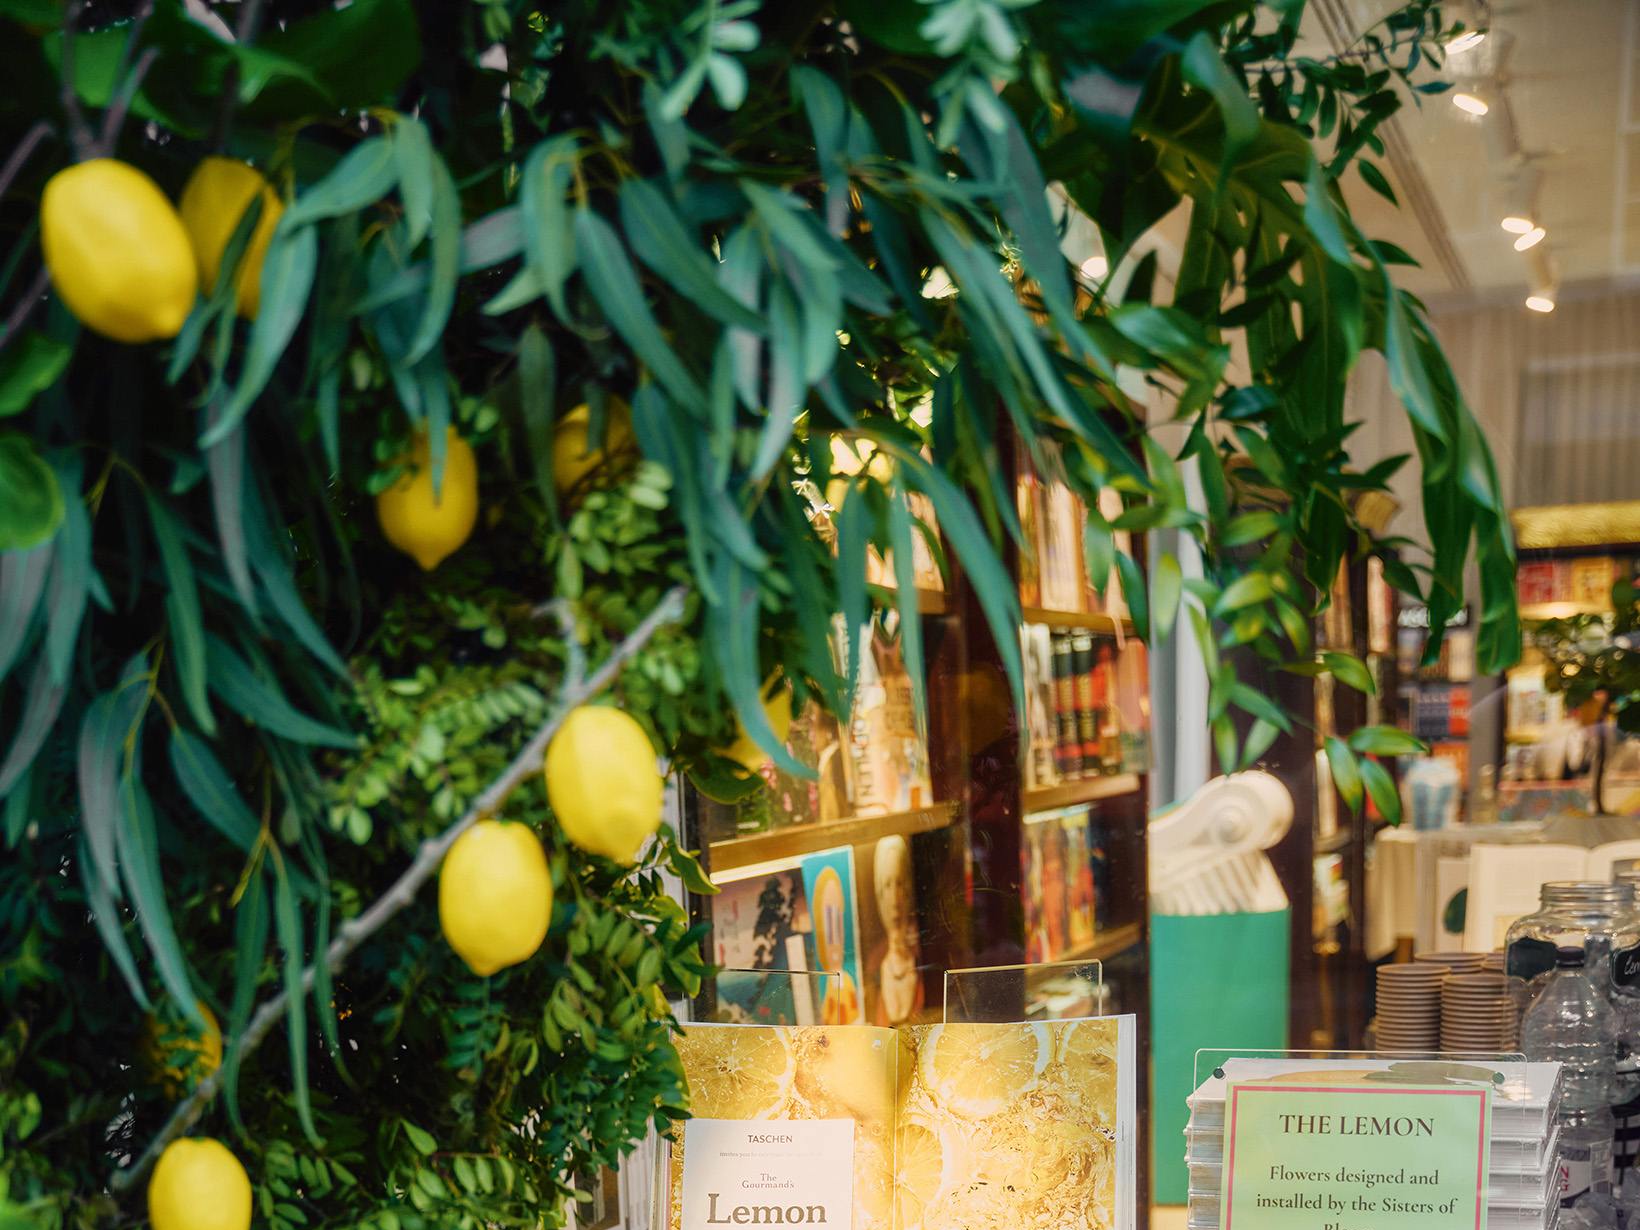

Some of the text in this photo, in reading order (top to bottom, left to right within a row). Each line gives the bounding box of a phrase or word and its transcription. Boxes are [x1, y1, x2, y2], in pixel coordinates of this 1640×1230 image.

[1279, 1114, 1434, 1137] THE LEMON
[748, 1135, 793, 1143] TASCHEN
[760, 1173, 776, 1181] The
[1270, 1165, 1439, 1189] Flowers designed and
[707, 1193, 827, 1224] Lemon
[1256, 1193, 1458, 1215] installed by the Sisters of
